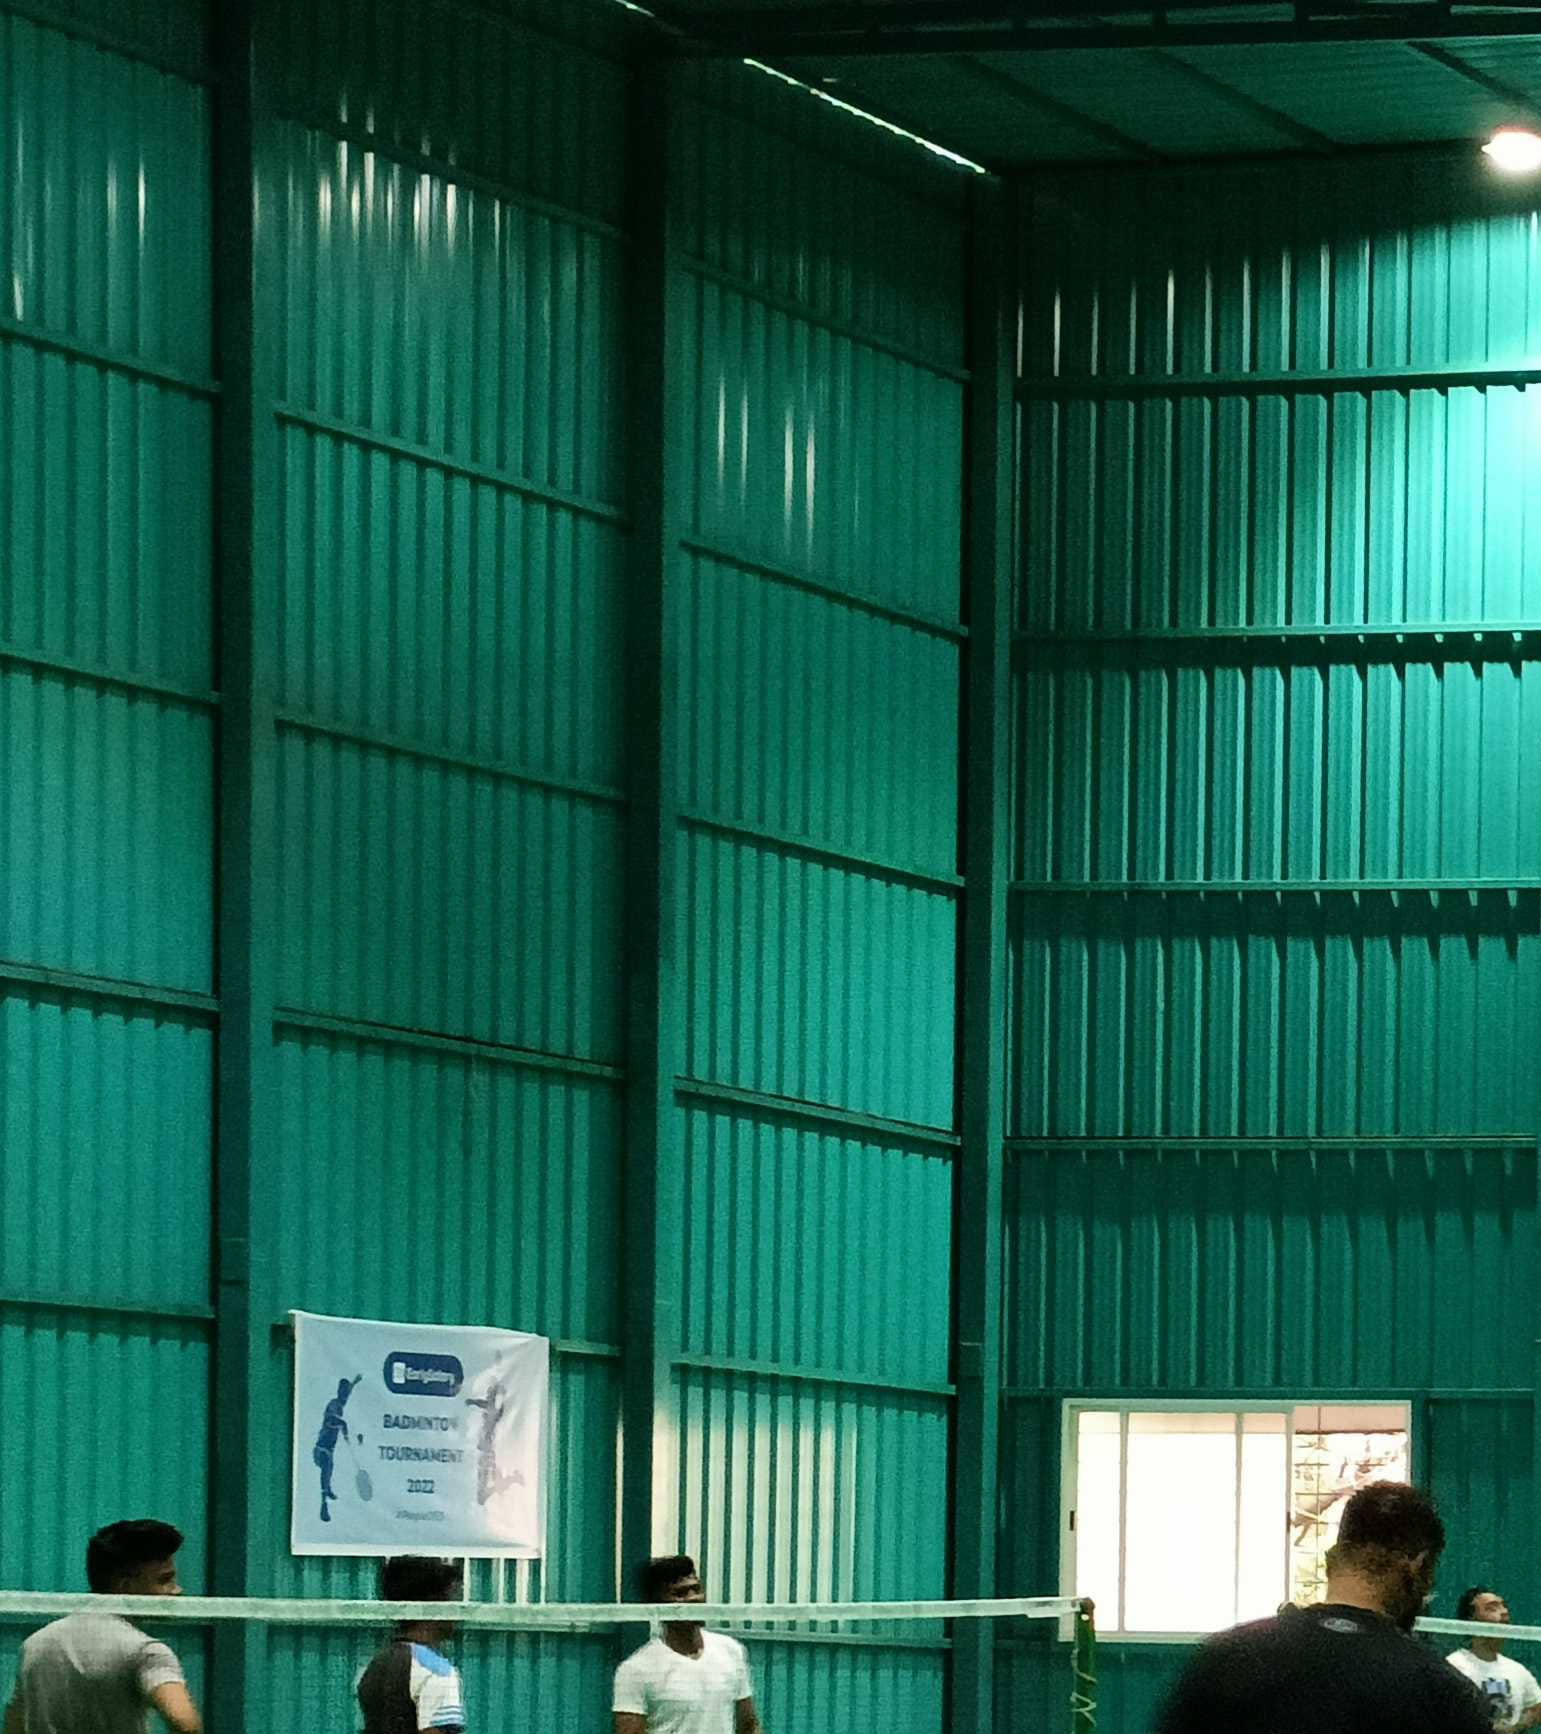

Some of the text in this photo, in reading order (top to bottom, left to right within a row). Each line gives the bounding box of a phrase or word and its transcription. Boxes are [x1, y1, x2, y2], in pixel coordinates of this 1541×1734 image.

[383, 1413, 459, 1431] BADMINTON
[378, 1445, 464, 1463] TOURNAMENT
[406, 1478, 435, 1494] 2022
